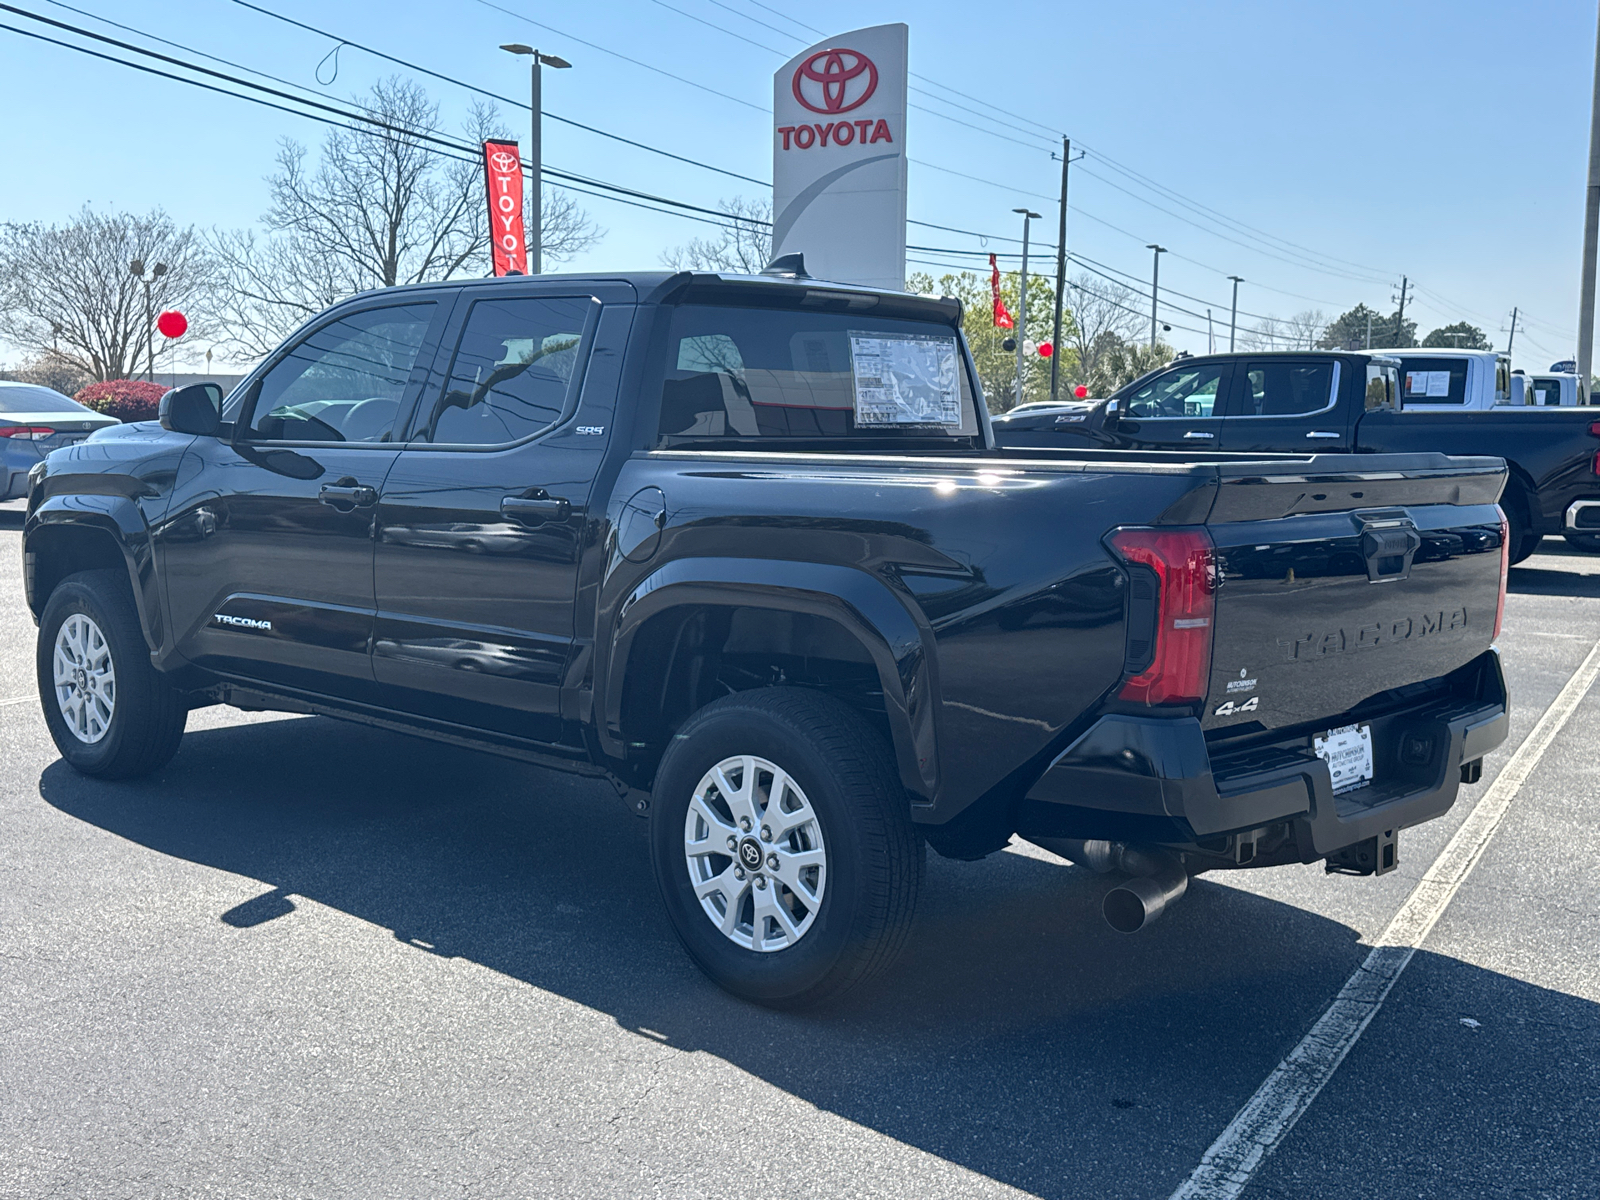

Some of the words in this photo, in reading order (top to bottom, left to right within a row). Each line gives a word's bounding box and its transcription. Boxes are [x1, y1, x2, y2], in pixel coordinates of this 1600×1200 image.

[778, 118, 893, 151] TOYOTA
[497, 176, 518, 271] TOYOT
[575, 426, 605, 436] SR5
[214, 613, 272, 631] TACOMA
[1276, 606, 1468, 661] TACOMA
